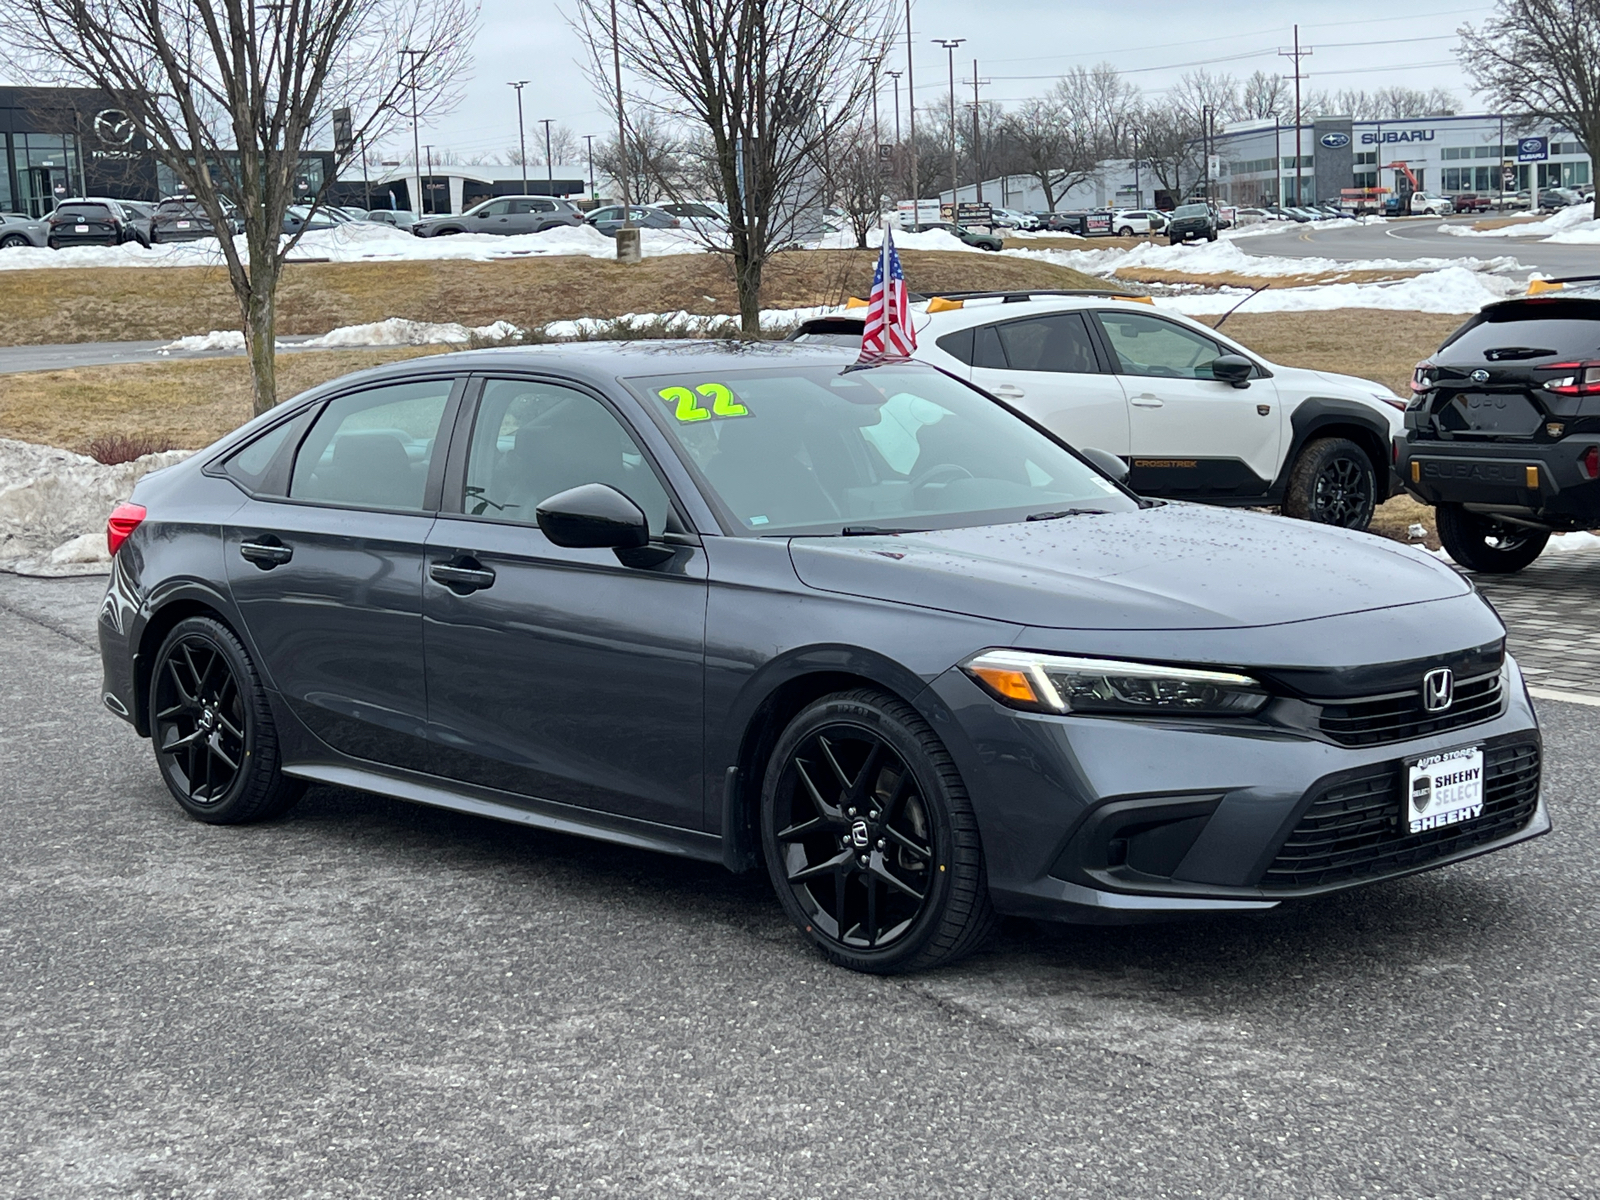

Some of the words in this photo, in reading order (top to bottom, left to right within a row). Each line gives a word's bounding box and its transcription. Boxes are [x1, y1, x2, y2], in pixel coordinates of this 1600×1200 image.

[1361, 130, 1435, 144] SUBARU
[1087, 220, 1110, 228] GMC
[658, 383, 748, 422] 22
[1135, 460, 1197, 468] CROSSTREK
[1424, 462, 1518, 481] SUBARU
[1417, 754, 1441, 768] AUTO
[1443, 747, 1478, 761] STORES
[1435, 767, 1480, 788] SHEEHY
[1435, 782, 1480, 806] SELECT
[1410, 804, 1483, 834] SHEEHY
